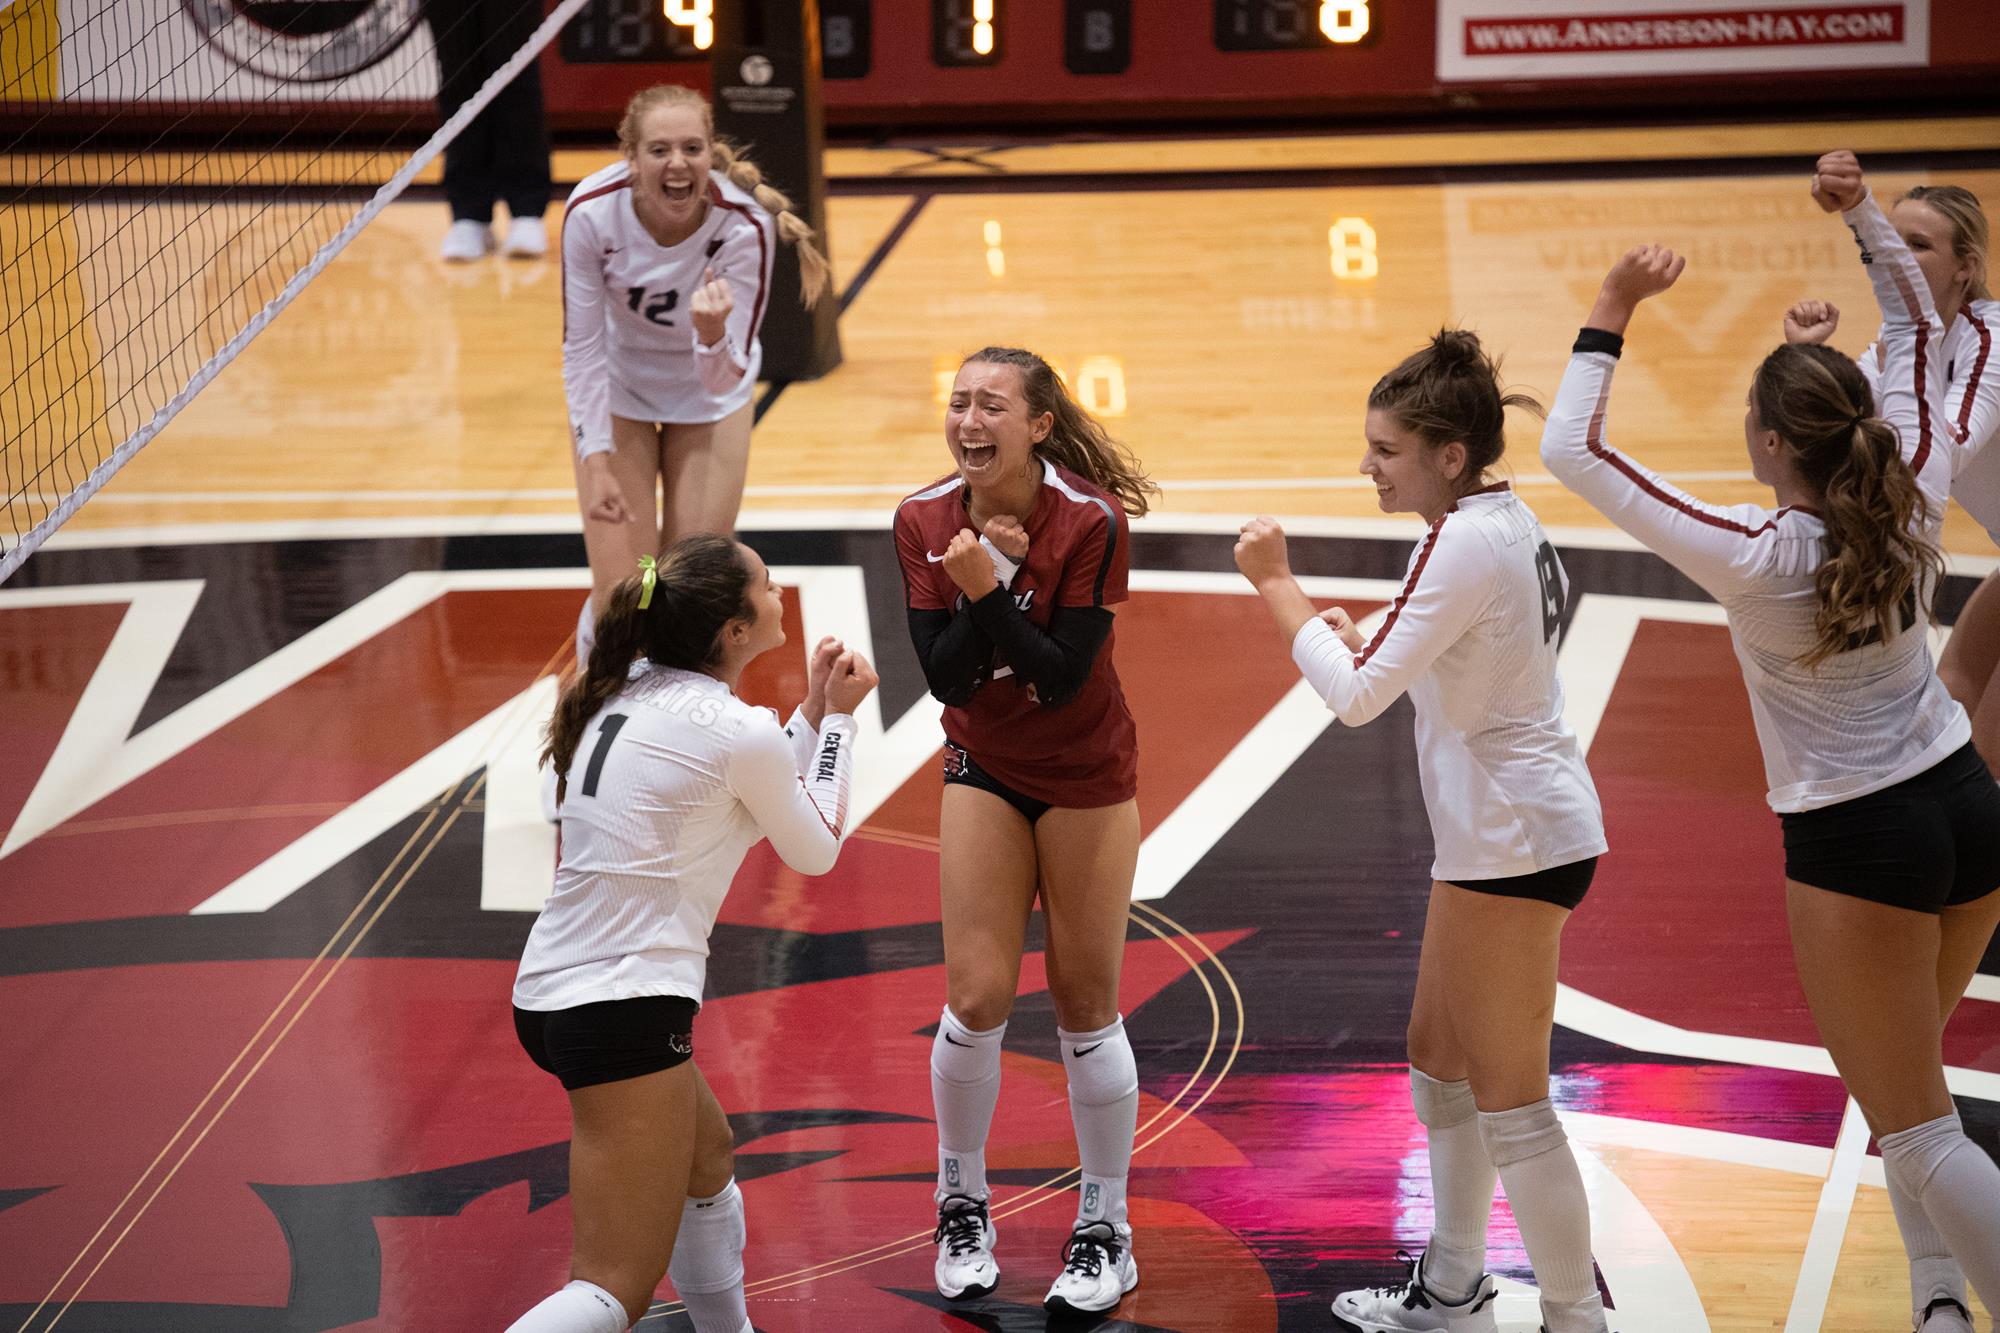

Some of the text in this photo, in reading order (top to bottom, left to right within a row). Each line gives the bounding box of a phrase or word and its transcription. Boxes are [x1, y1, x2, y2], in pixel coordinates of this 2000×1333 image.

[663, 0, 714, 50] 4
[627, 286, 679, 327] 12
[581, 713, 629, 797] 1
[816, 731, 841, 783] CENTRAL
